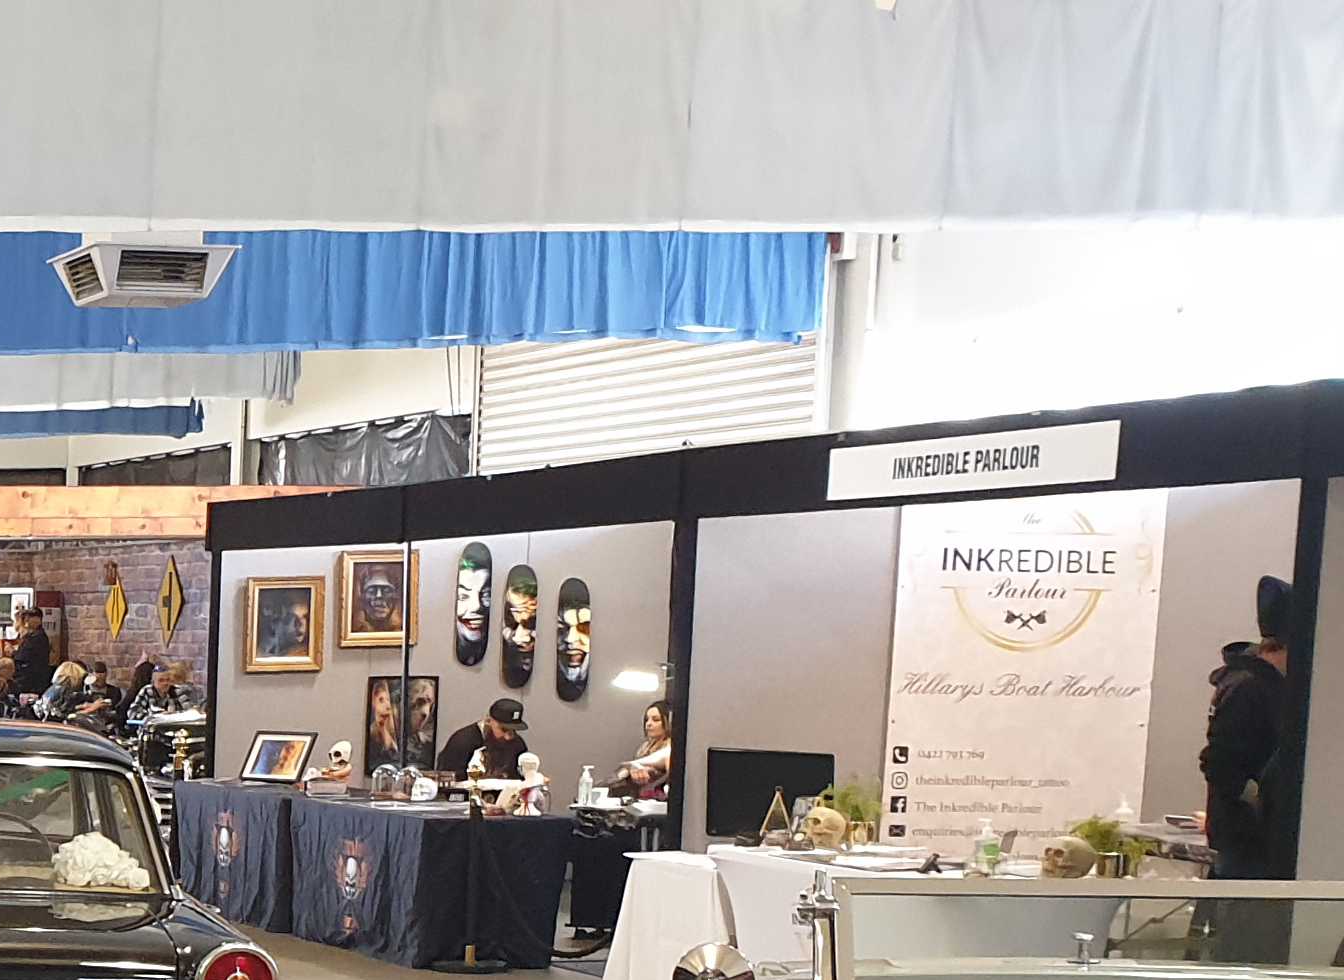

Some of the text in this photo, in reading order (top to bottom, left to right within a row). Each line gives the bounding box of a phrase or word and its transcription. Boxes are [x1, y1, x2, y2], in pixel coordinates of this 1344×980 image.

[892, 445, 1040, 479] INKREDIBLE PARLOUR
[942, 547, 1117, 574] INKREDIBLE
[987, 577, 1068, 600] Parlour
[897, 671, 1141, 704] Hillarys Boat Harbour
[914, 801, 936, 813] The
